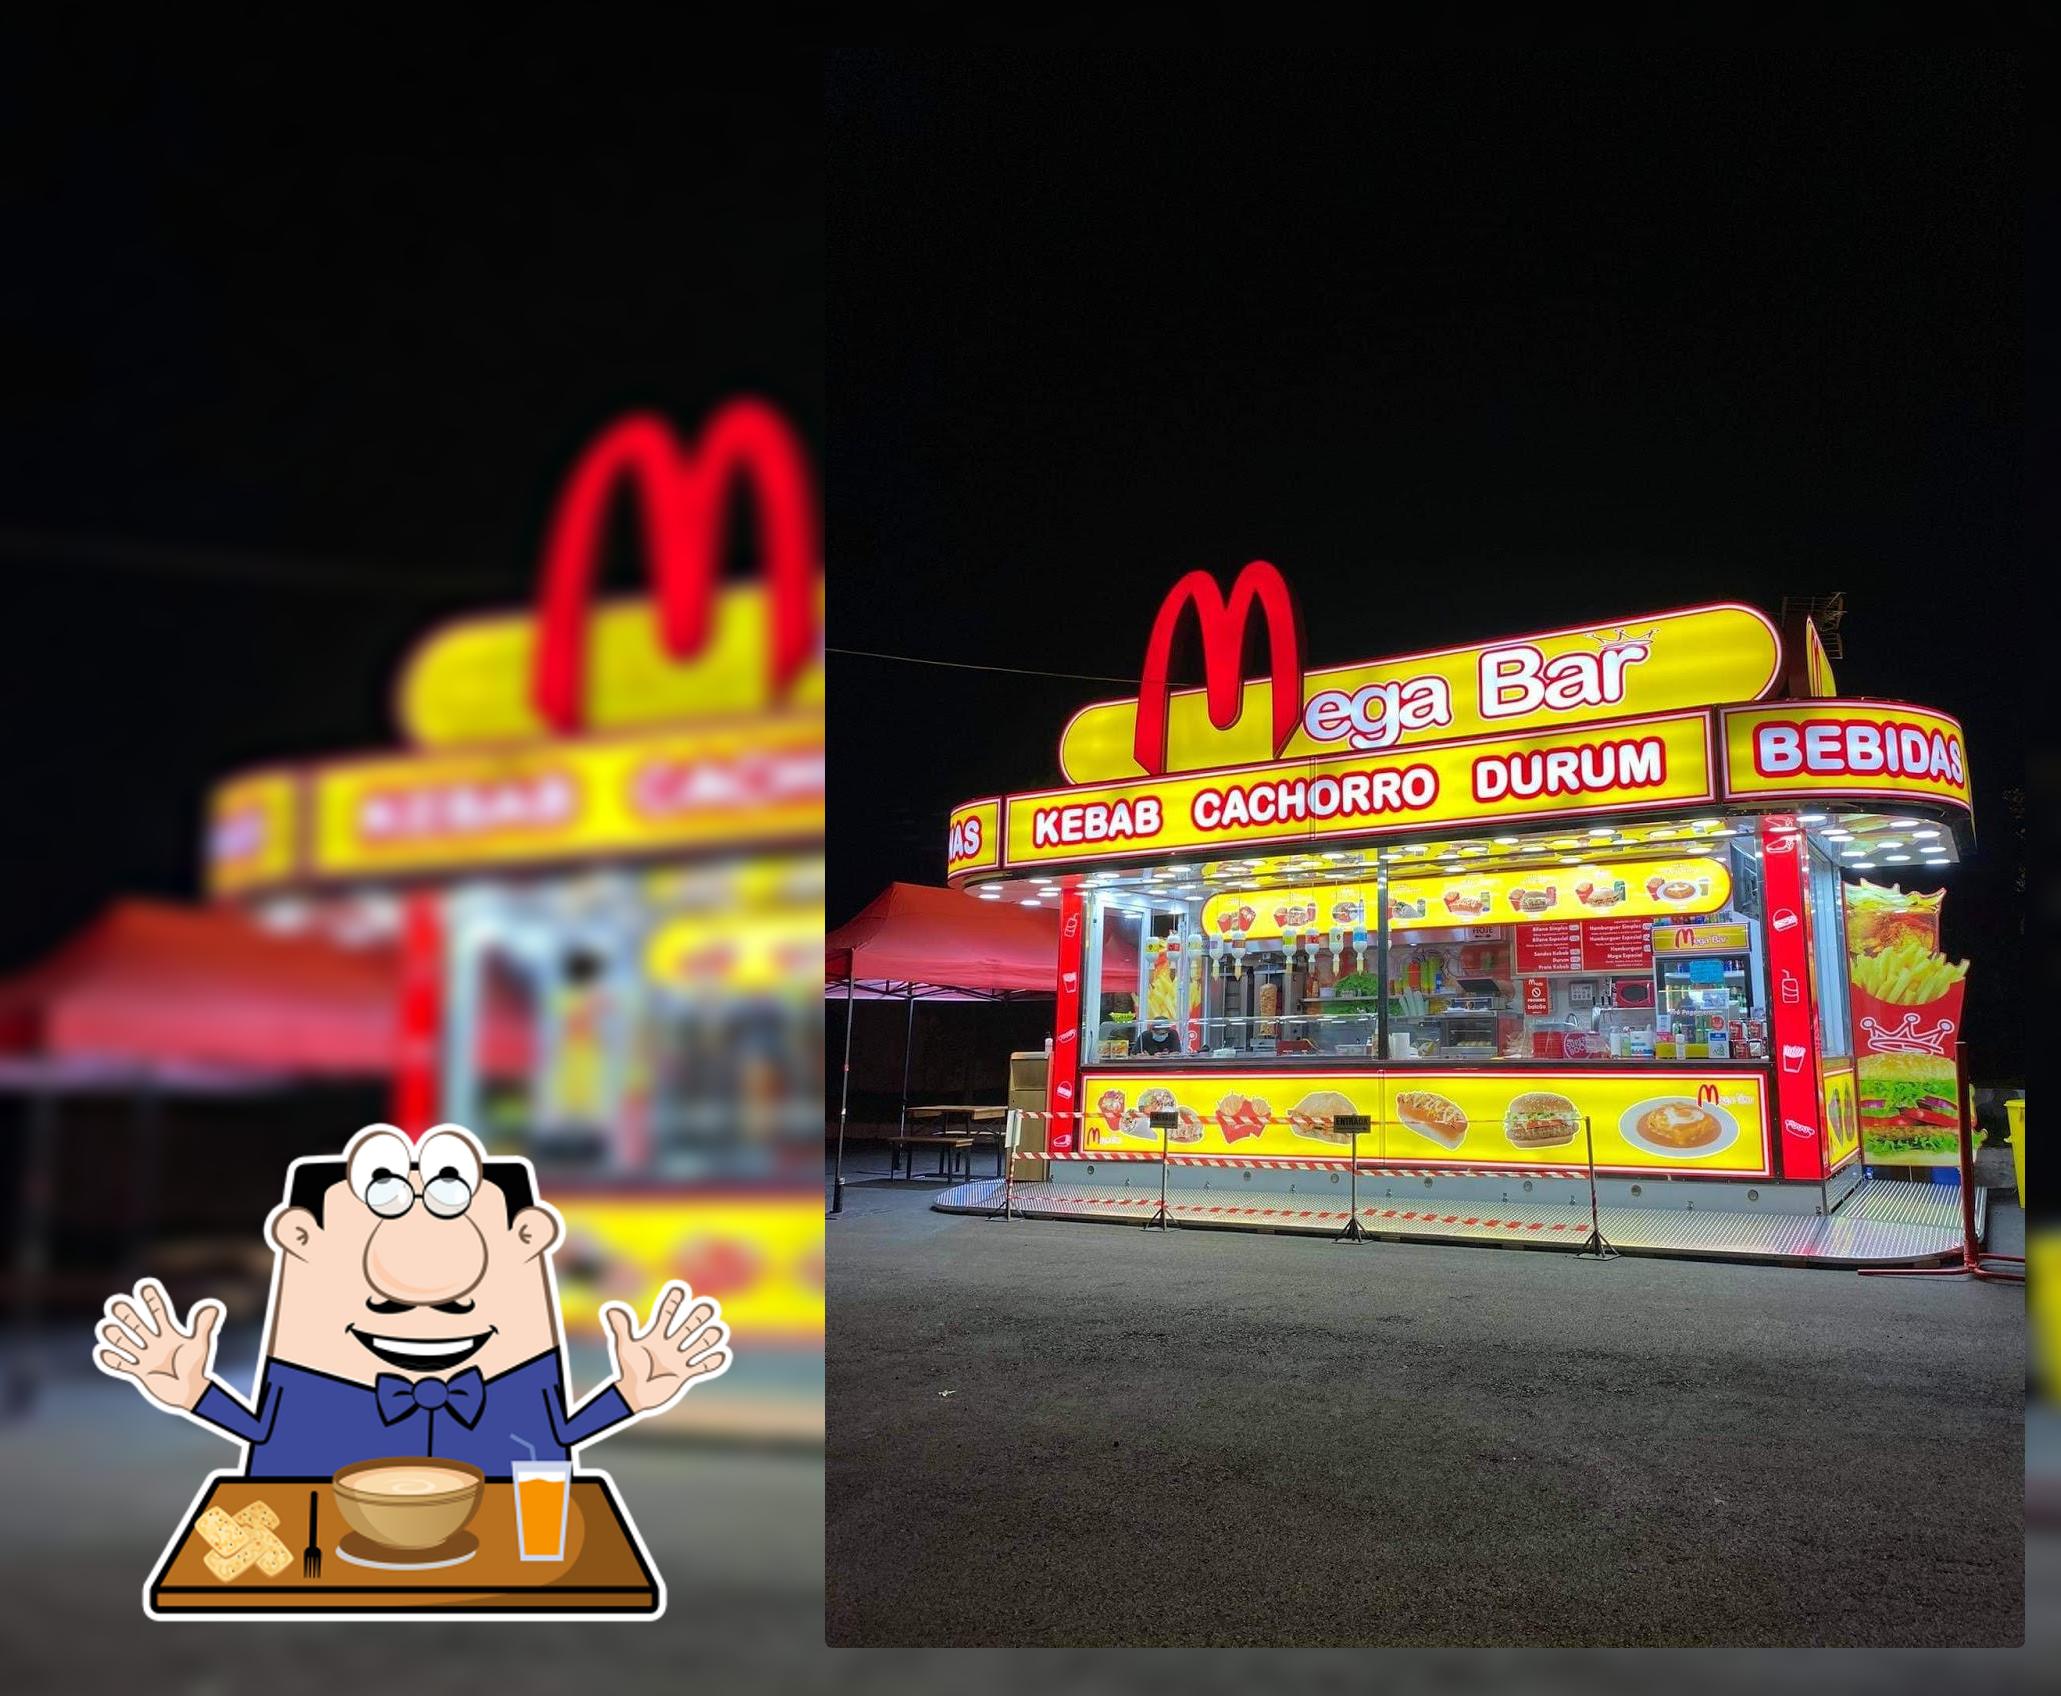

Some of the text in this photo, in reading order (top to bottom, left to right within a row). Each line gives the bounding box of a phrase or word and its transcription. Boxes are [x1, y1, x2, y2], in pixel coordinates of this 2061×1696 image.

[1478, 643, 1650, 720] Bar
[1757, 723, 1965, 786] BEBIDAS
[1034, 740, 1663, 847] KEBAB CACHORRO DURUM
